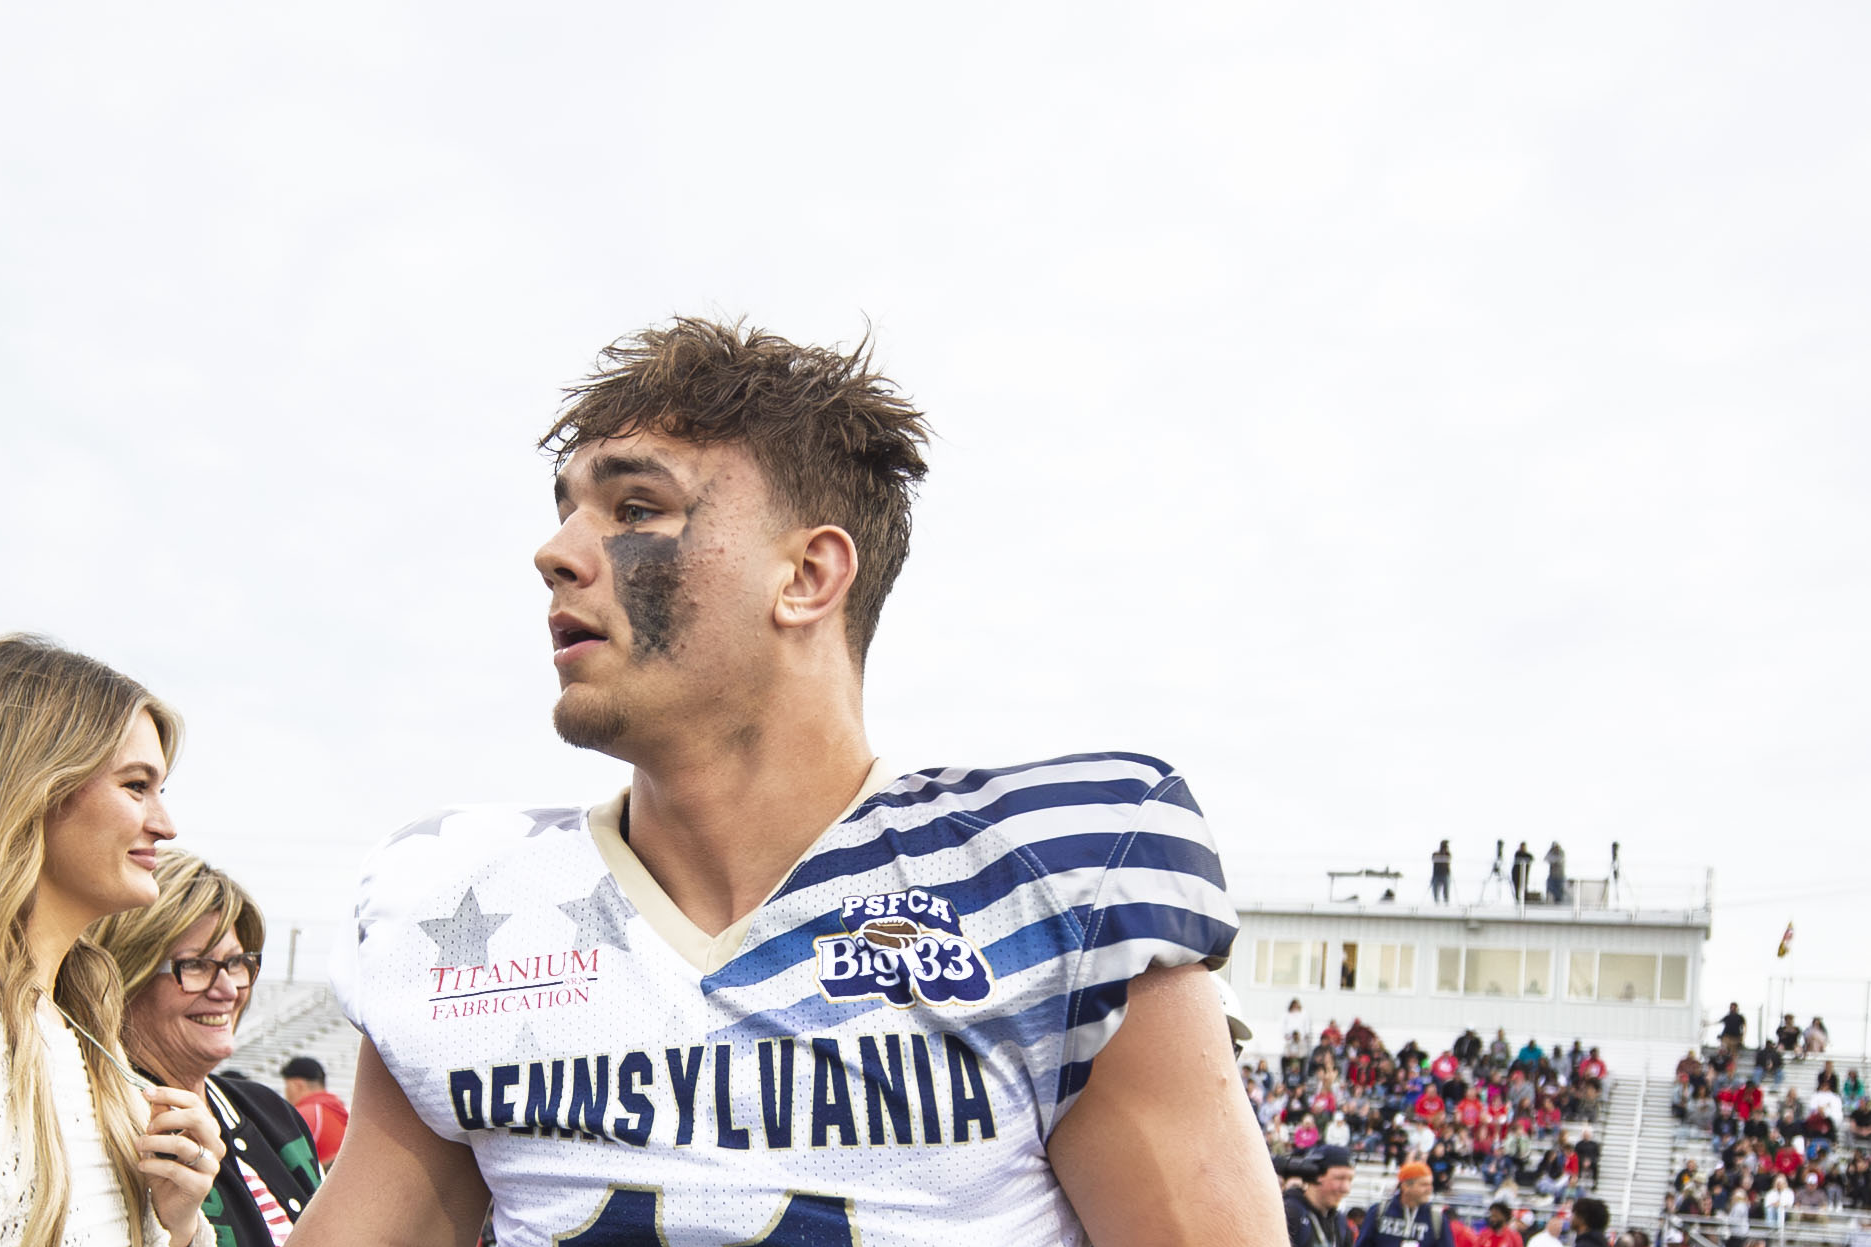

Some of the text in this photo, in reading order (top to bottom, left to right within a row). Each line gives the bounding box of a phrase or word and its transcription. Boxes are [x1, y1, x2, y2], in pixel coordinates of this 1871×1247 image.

[842, 889, 952, 923] PSFCA
[429, 949, 600, 993] TITANIUM
[819, 936, 975, 987] Big 33
[432, 986, 590, 1020] FABRICATION
[447, 1032, 999, 1151] PENNSYLVANIA
